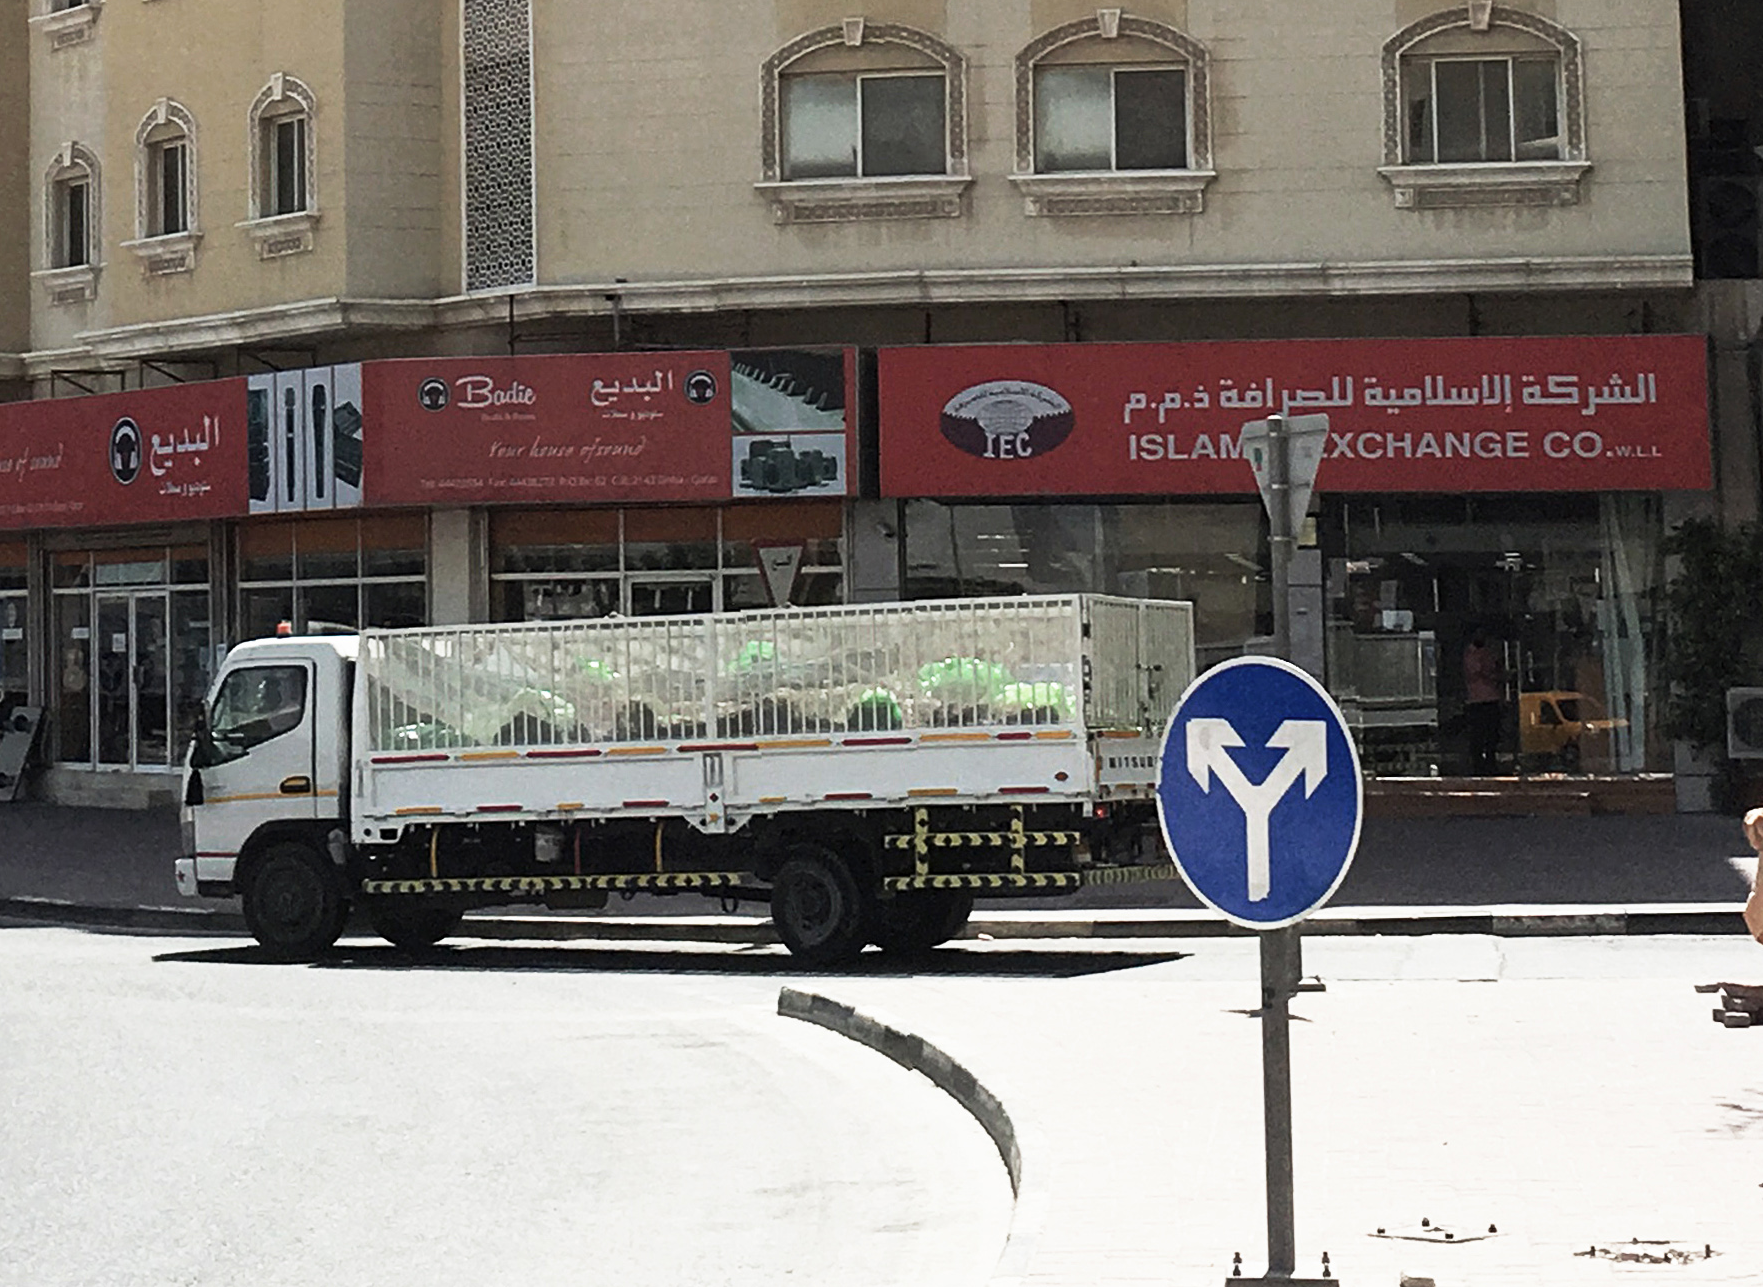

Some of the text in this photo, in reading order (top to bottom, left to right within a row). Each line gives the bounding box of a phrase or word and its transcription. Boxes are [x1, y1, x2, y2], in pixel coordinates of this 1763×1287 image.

[455, 375, 537, 408] Badie
[591, 369, 673, 407] البديع
[1219, 376, 1353, 417] للصرافة
[1522, 373, 1657, 416] الشركة
[150, 415, 220, 476] البديع
[489, 440, 525, 457] Your
[983, 432, 1032, 458] IEC
[1129, 434, 1246, 460] ISLAM
[1321, 431, 1530, 458] XCHANGE
[1543, 430, 1613, 458] CO.
[1109, 755, 1158, 769] MITSUB
